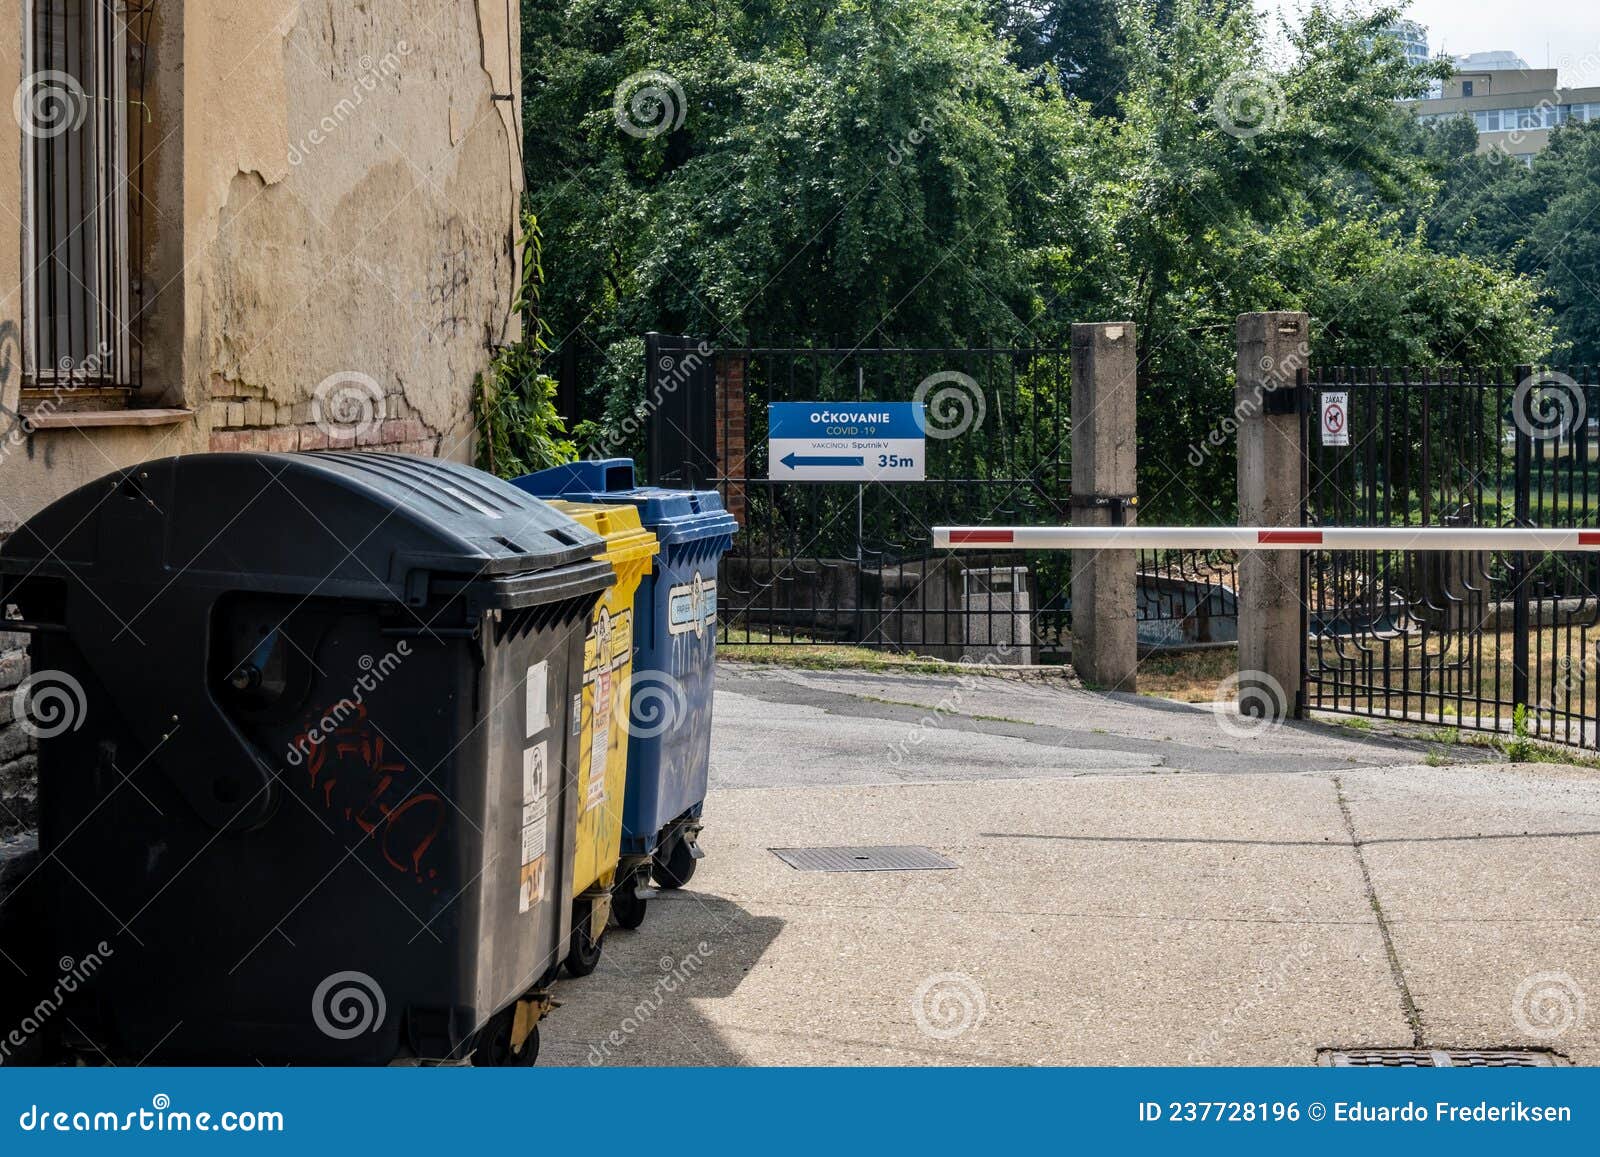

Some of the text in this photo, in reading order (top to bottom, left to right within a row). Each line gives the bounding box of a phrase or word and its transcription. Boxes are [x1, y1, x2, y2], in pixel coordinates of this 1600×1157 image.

[810, 410, 890, 424] OČKOVANIE
[826, 426, 859, 435] COVID
[851, 441, 882, 450] Sputnik
[877, 454, 914, 467] 35m
